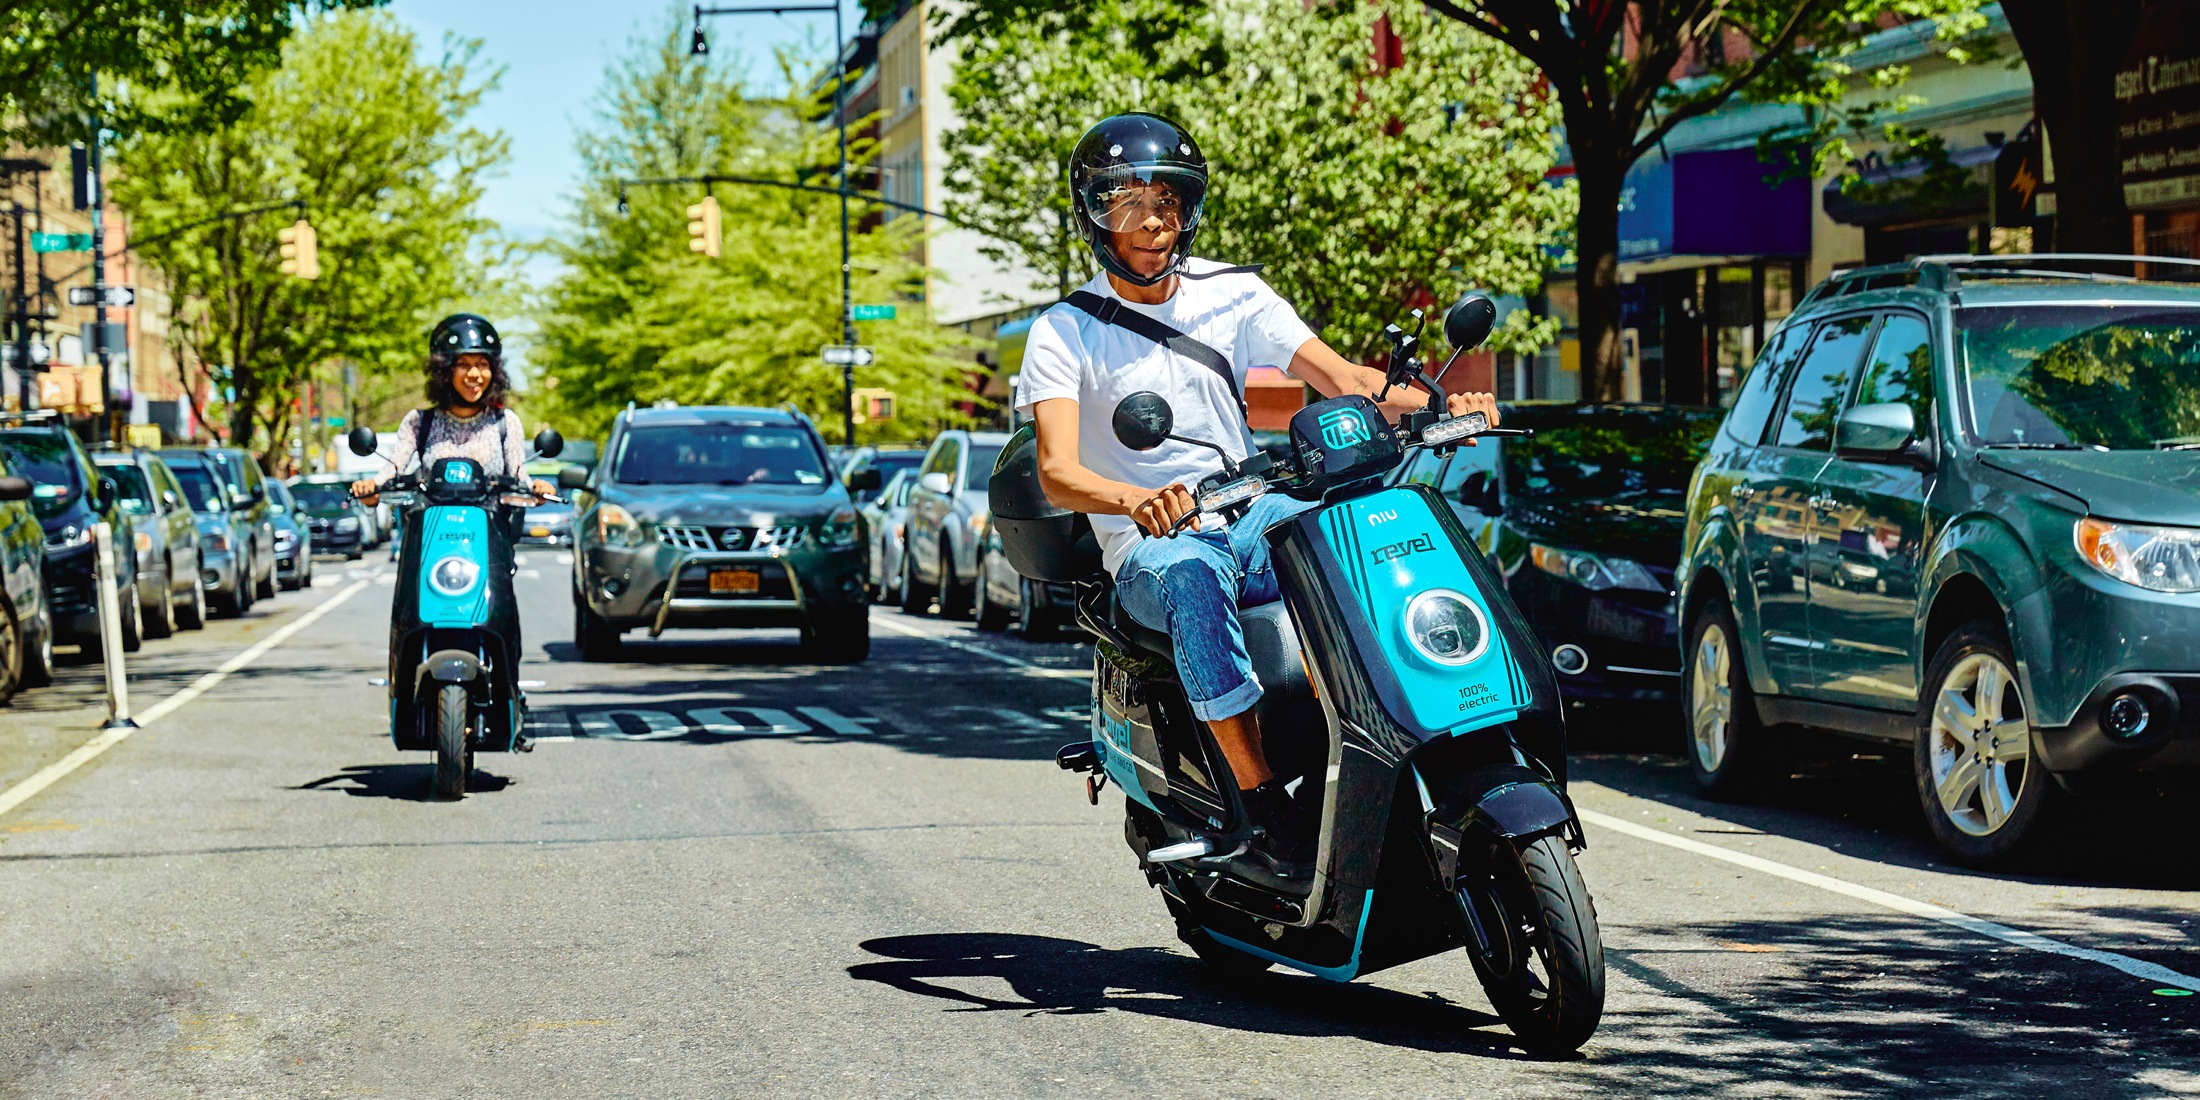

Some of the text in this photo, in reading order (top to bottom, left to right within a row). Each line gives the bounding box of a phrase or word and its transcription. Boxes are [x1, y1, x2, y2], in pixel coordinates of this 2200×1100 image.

[1371, 532, 1437, 566] revel
[1458, 683, 1489, 699] 100%
[1458, 692, 1500, 712] electric
